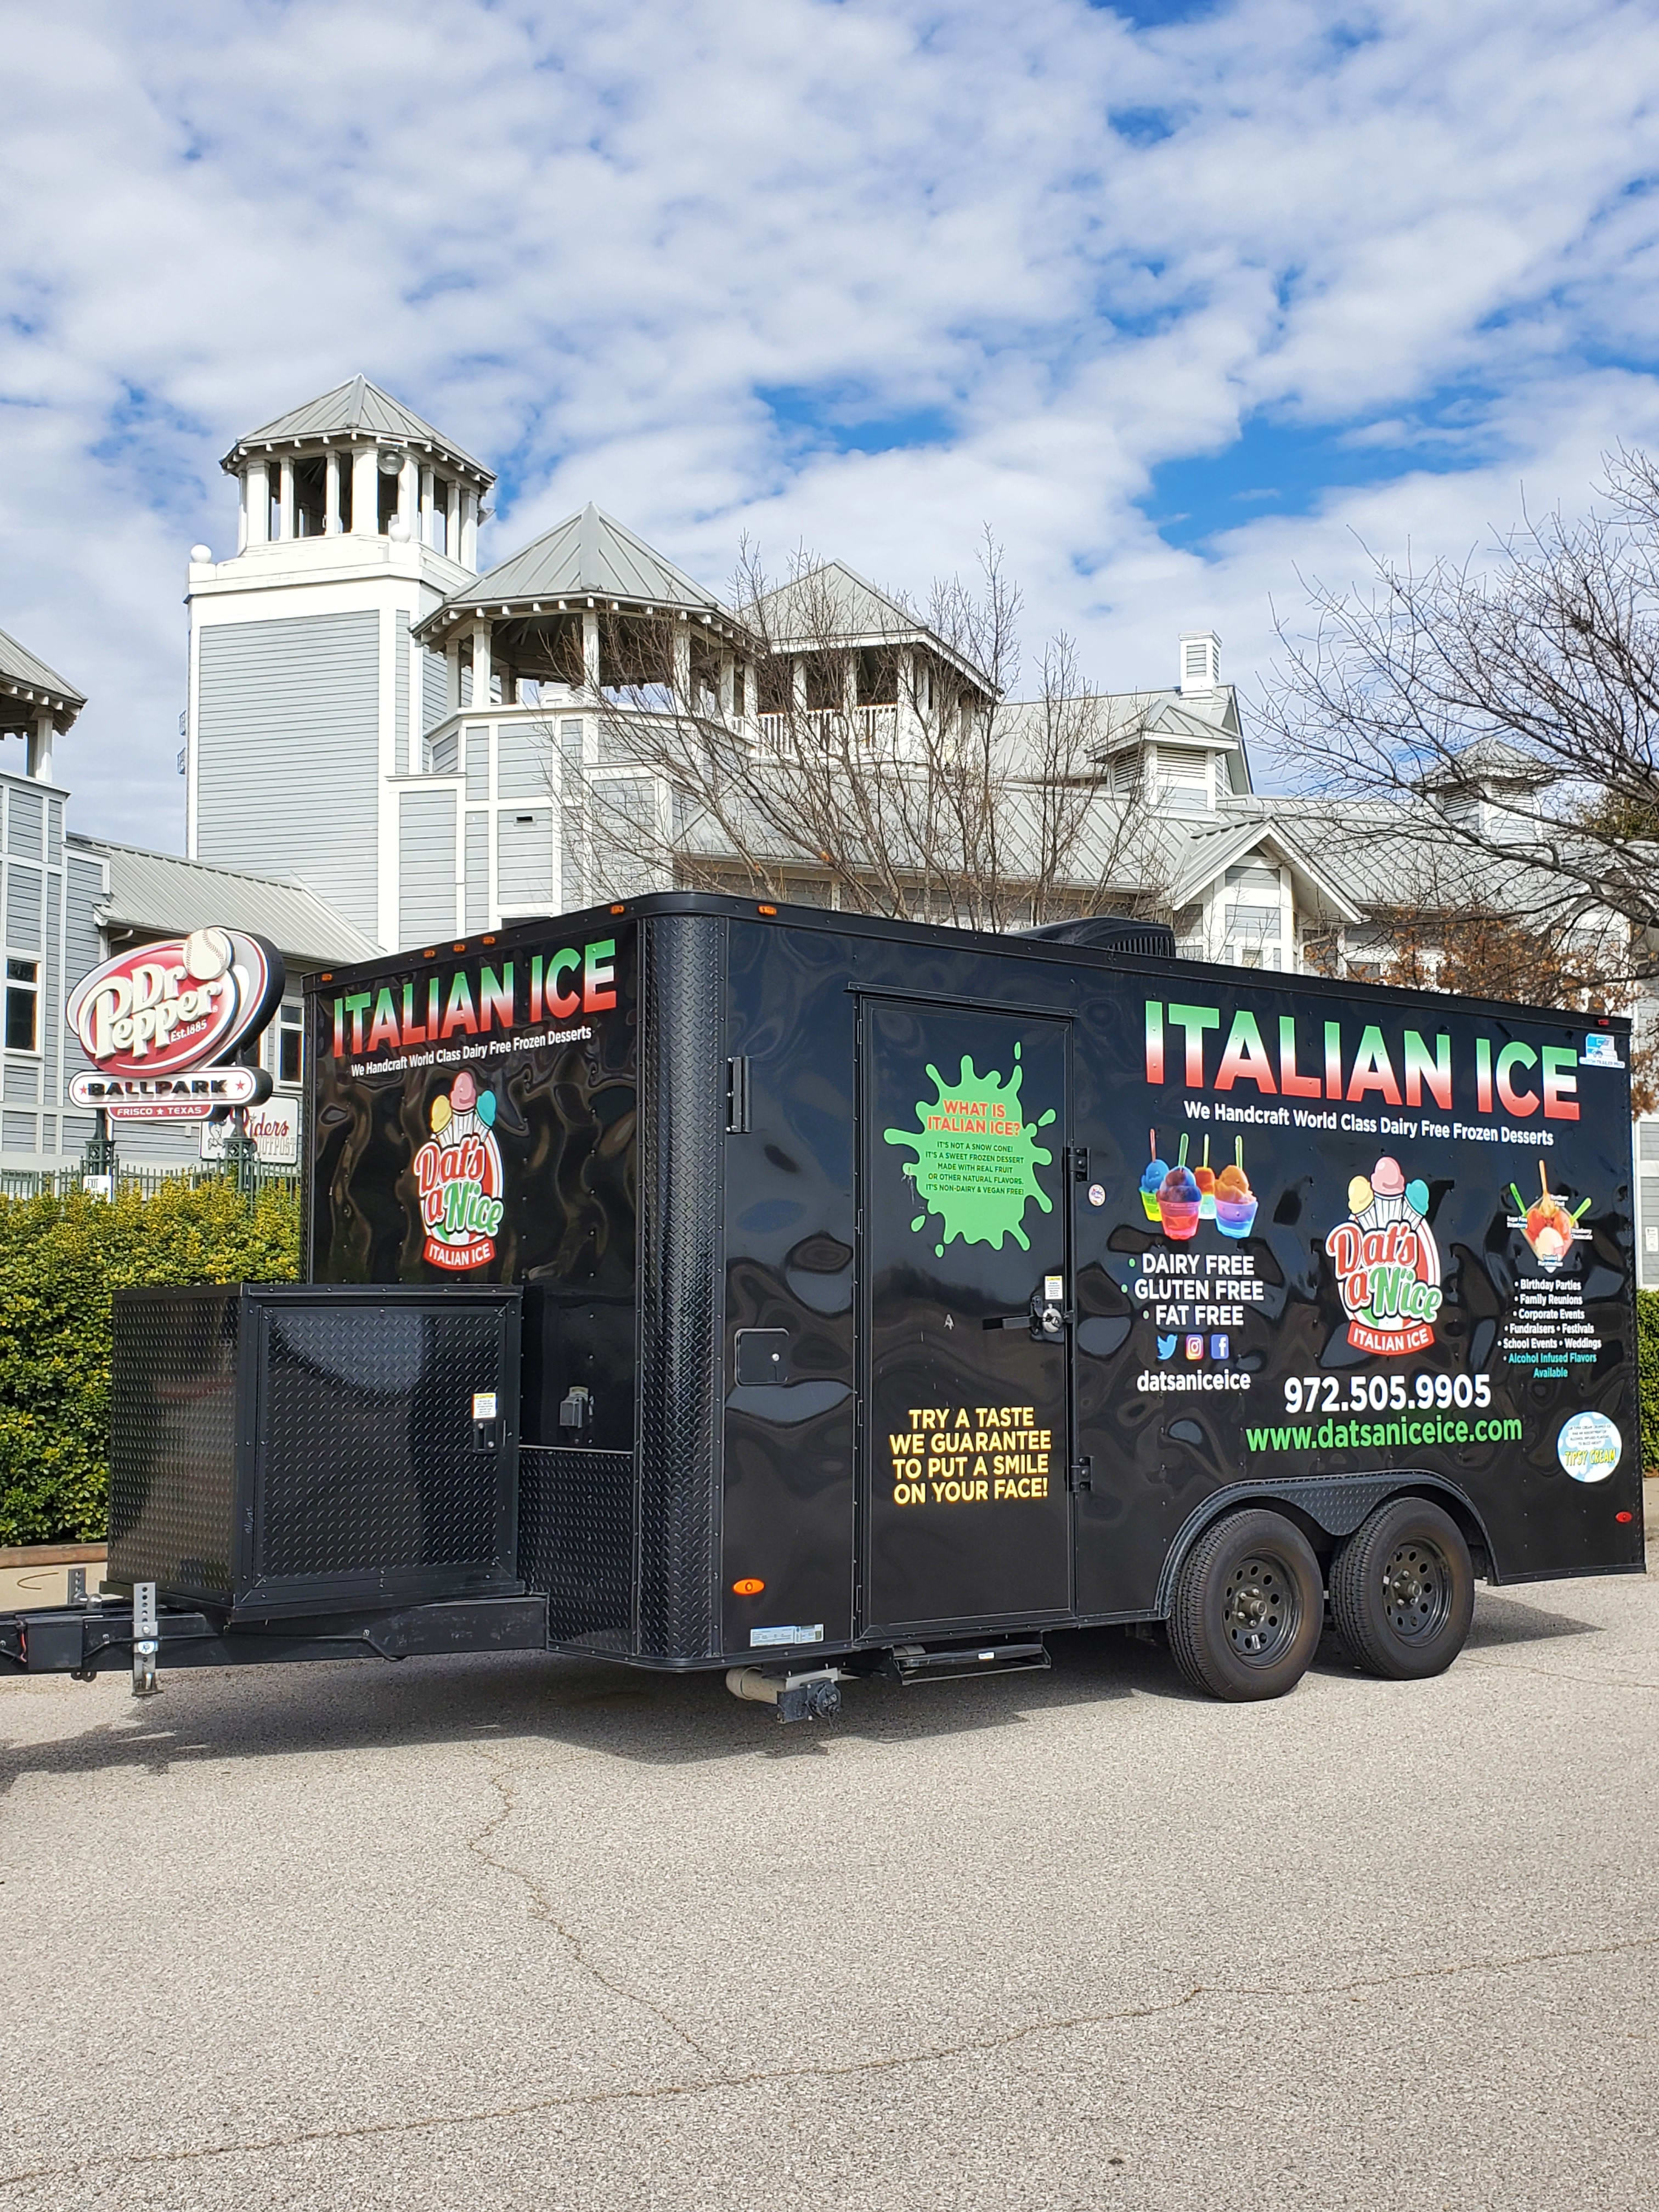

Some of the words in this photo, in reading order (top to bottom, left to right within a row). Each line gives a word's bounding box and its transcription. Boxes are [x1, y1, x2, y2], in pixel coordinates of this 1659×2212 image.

[131, 963, 188, 1010] Dr
[333, 962, 514, 1058] ITALIAN
[529, 939, 617, 1023] ICE
[78, 977, 223, 1059] Pepper
[351, 1064, 364, 1077] We
[366, 1057, 408, 1075] Handcraft
[410, 1050, 435, 1068] World
[436, 1047, 461, 1063] Class
[462, 1043, 488, 1060] Dairy
[489, 1041, 511, 1056] Free
[514, 1036, 546, 1052] Frozen
[548, 1025, 592, 1046] Desserts
[1145, 1000, 1453, 1110] ITALIAN
[1476, 1038, 1580, 1121] ICE
[87, 1079, 228, 1096] BALLPARK
[117, 1107, 153, 1115] FRISCO
[167, 1107, 202, 1115] TEXAS
[943, 1099, 988, 1116] WHAT
[992, 1104, 1006, 1118] IS
[927, 1116, 986, 1134] ITALIAN
[990, 1121, 1020, 1136] ICE?
[1184, 1101, 1211, 1121] We
[1214, 1102, 1290, 1126] Handcraft
[1293, 1110, 1337, 1130] World
[1341, 1114, 1377, 1133] Class
[1380, 1116, 1418, 1139] Dairy
[1421, 1120, 1450, 1139] Free
[1453, 1122, 1498, 1142] Frozen
[1500, 1126, 1554, 1147] Desserts
[414, 1136, 485, 1197] Dat's
[945, 1152, 968, 1160] SWEET
[969, 1154, 995, 1162] FROZEN
[997, 1155, 1024, 1164] DESSERT
[939, 1184, 975, 1193] NON-DAIRY
[962, 1175, 992, 1183] NATURAL
[994, 1176, 1024, 1184] FLAVORS.
[426, 1187, 445, 1225] a
[429, 1243, 469, 1266] ITALIAN
[472, 1243, 490, 1261] ICE
[1327, 1222, 1417, 1279] Dat's
[1142, 1253, 1200, 1274] DAIRY
[1206, 1255, 1254, 1275] FREE
[1135, 1278, 1209, 1300] GLUTEN
[1215, 1280, 1264, 1300] FREE
[1347, 1268, 1370, 1310] a
[1521, 1279, 1554, 1292] Birthday
[1555, 1279, 1582, 1291] Parties
[1520, 1294, 1547, 1306] Family
[1548, 1294, 1583, 1305] Reunions
[1155, 1305, 1189, 1325] FAT
[1194, 1305, 1244, 1325] FREE
[1519, 1308, 1559, 1321] Corporate
[1560, 1309, 1585, 1319] Events
[1353, 1328, 1405, 1351] ITALIAN
[1407, 1327, 1429, 1349] ICE
[1510, 1323, 1555, 1334] Fundraisers
[1562, 1323, 1594, 1334] Festivals
[1503, 1338, 1530, 1348] School
[1531, 1338, 1558, 1348] Events
[1564, 1338, 1601, 1351] Weddings
[1508, 1353, 1539, 1364] Alcohol
[1541, 1352, 1568, 1363] Infused
[1570, 1352, 1597, 1363] Flavors
[1137, 1369, 1251, 1391] datsaniceice
[1533, 1368, 1568, 1378] Available
[1284, 1374, 1491, 1413] 972.505.9905
[909, 1408, 950, 1429] TRY
[955, 1408, 970, 1429] A
[975, 1407, 1034, 1428] TASTE
[889, 1434, 924, 1454] WE
[931, 1430, 1052, 1453] GUARANTEE
[1246, 1415, 1523, 1452] www.datsaniceice.com
[893, 1458, 922, 1479] TO
[928, 1457, 968, 1478] PUT
[973, 1455, 988, 1476] A
[993, 1453, 1048, 1475] SMILE
[1565, 1450, 1588, 1466] TIPSY
[1589, 1448, 1616, 1464] CREAM
[894, 1483, 926, 1504] ON
[932, 1480, 988, 1502] YOUR
[994, 1477, 1048, 1499] FACE!
